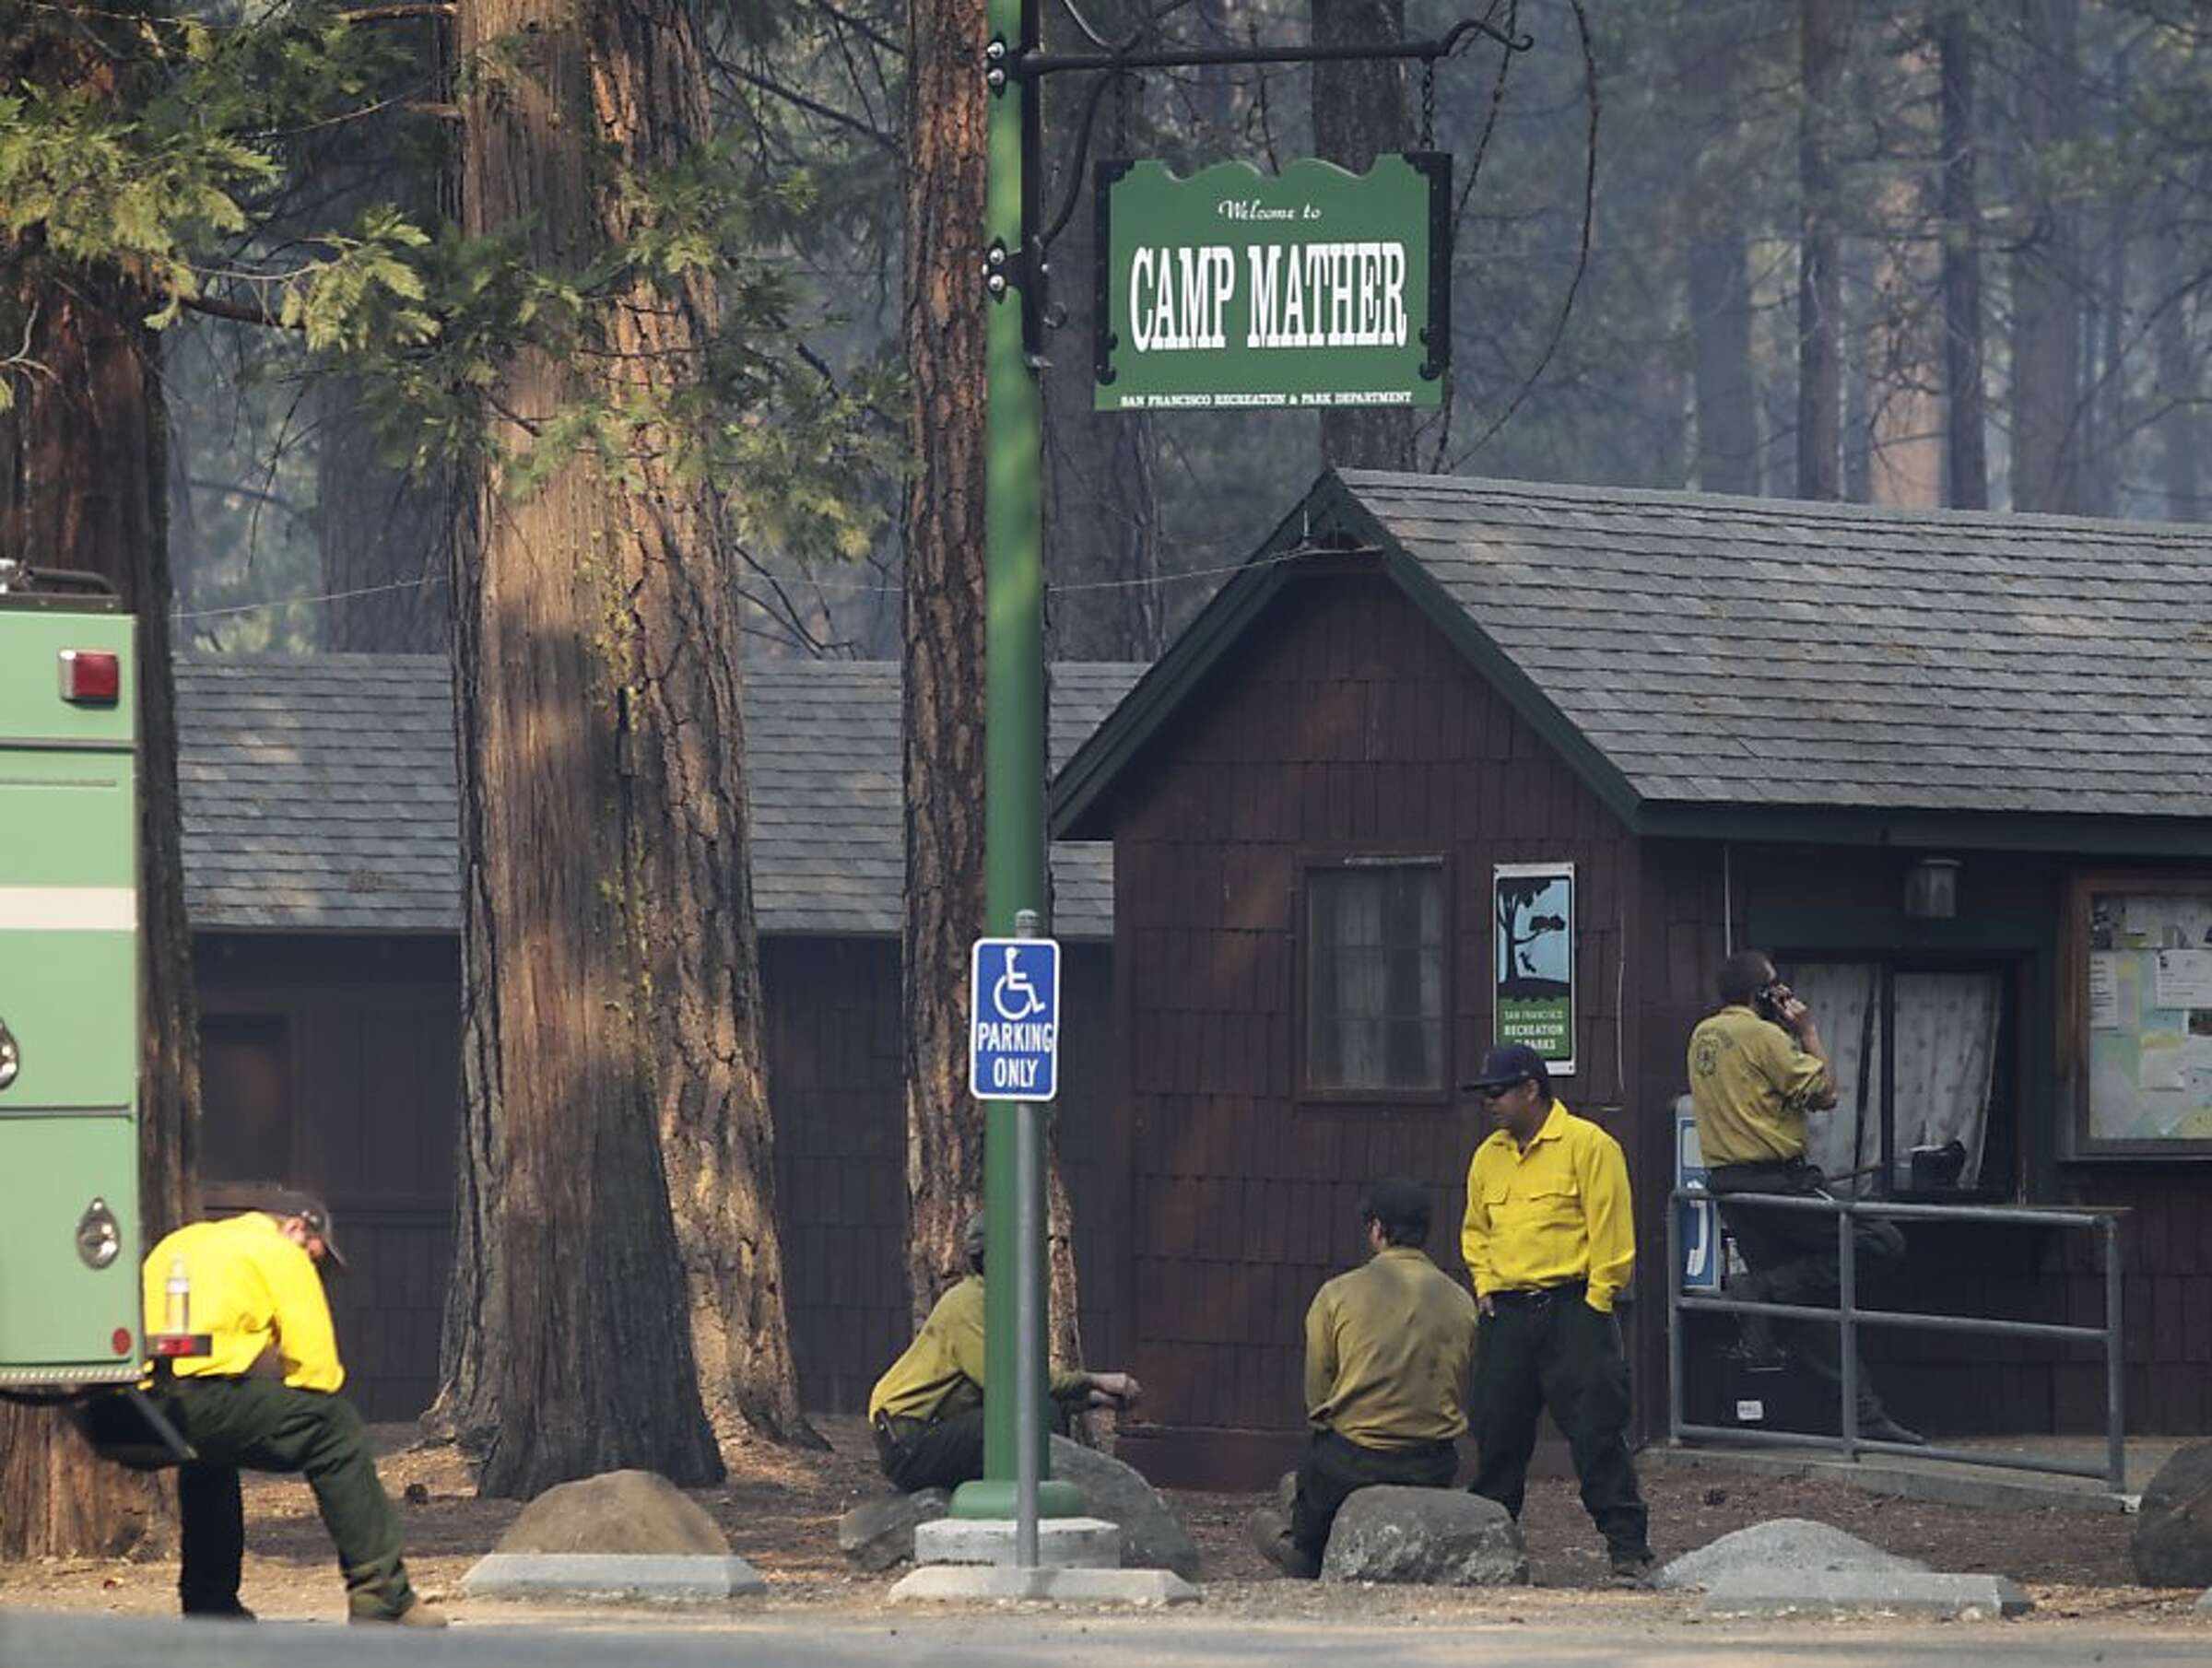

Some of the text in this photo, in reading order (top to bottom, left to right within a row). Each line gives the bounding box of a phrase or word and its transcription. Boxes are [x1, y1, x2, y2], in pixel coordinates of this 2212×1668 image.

[1218, 198, 1323, 220] Welcome to
[1130, 242, 1407, 352] CAMP MATHER
[1120, 391, 1412, 407] SAN FRANCISCO RECREATION & PARK DEPARTMENT
[978, 1022, 1053, 1052] PARKING
[1504, 1024, 1564, 1036] RECREATION
[993, 1057, 1039, 1088] ONLY
